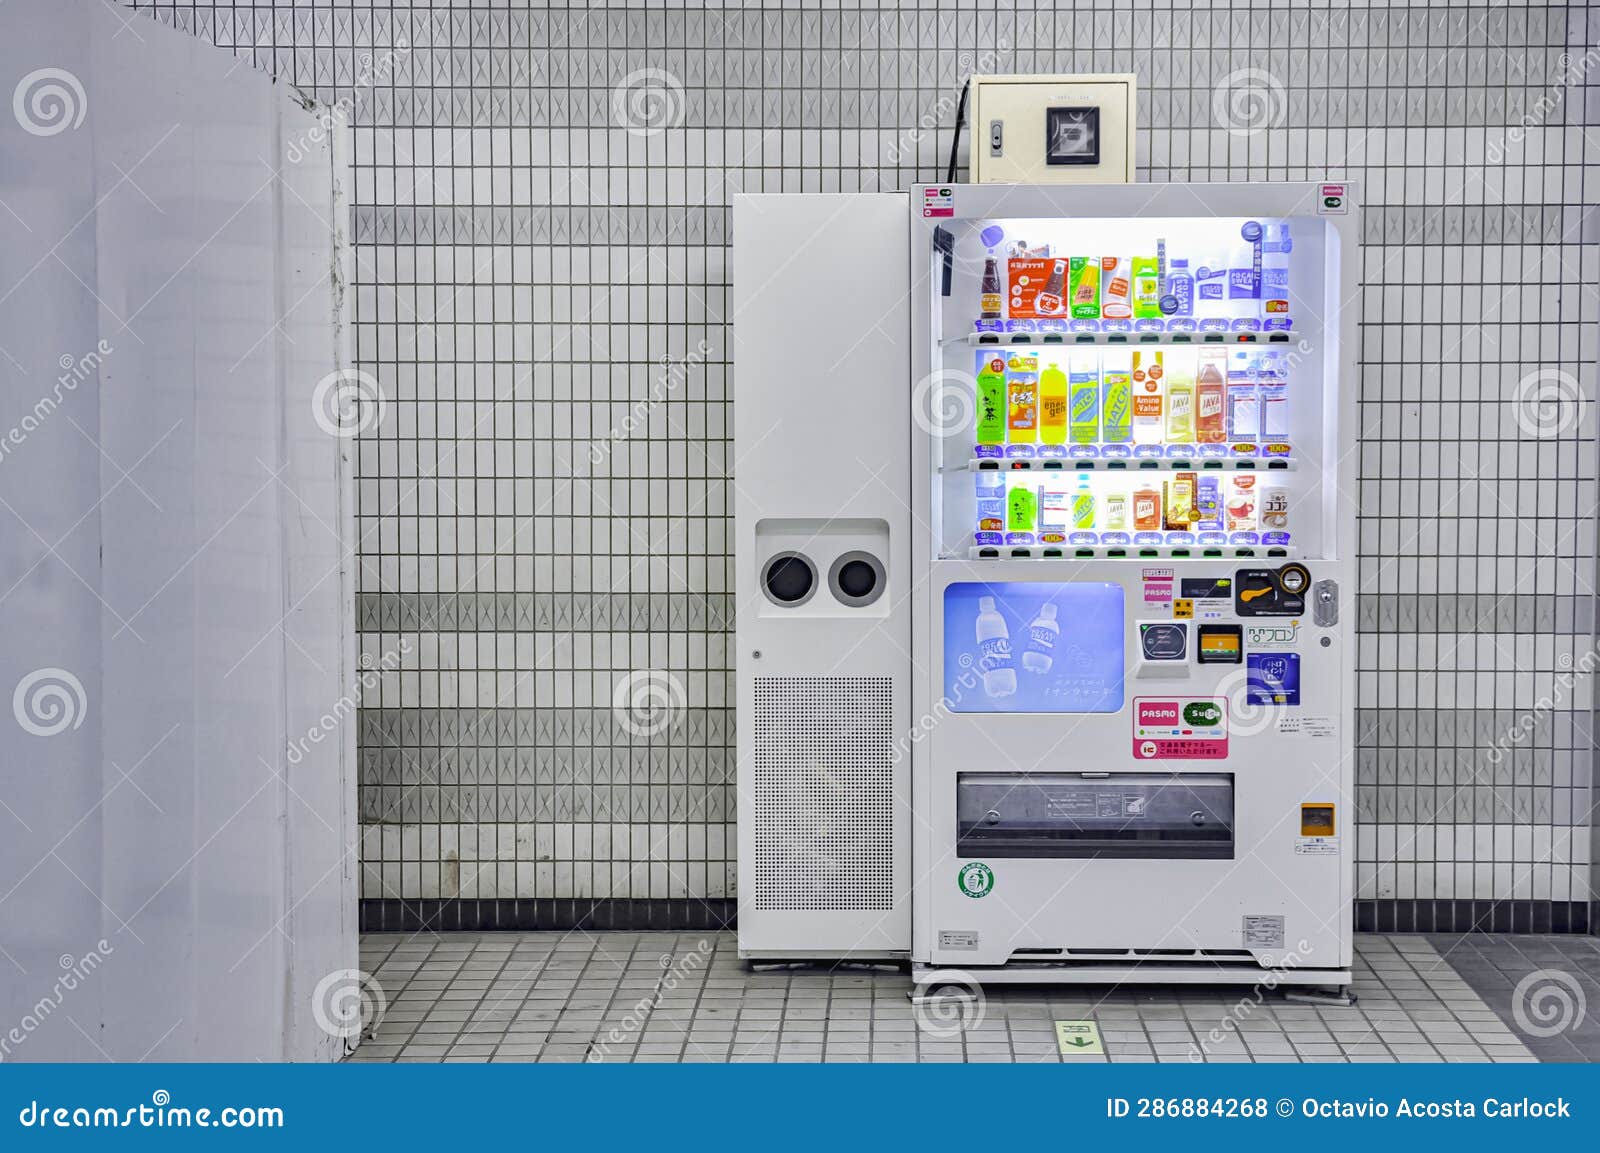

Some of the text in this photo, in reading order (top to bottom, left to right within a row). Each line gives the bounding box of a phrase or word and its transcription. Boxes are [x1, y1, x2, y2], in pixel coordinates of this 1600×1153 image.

[1137, 396, 1160, 404] Amino
[1172, 396, 1189, 408] JAVA
[1202, 396, 1219, 408] JAVA
[1044, 401, 1064, 410] ener
[1049, 405, 1066, 417] gen
[1141, 709, 1176, 718] PASMO
